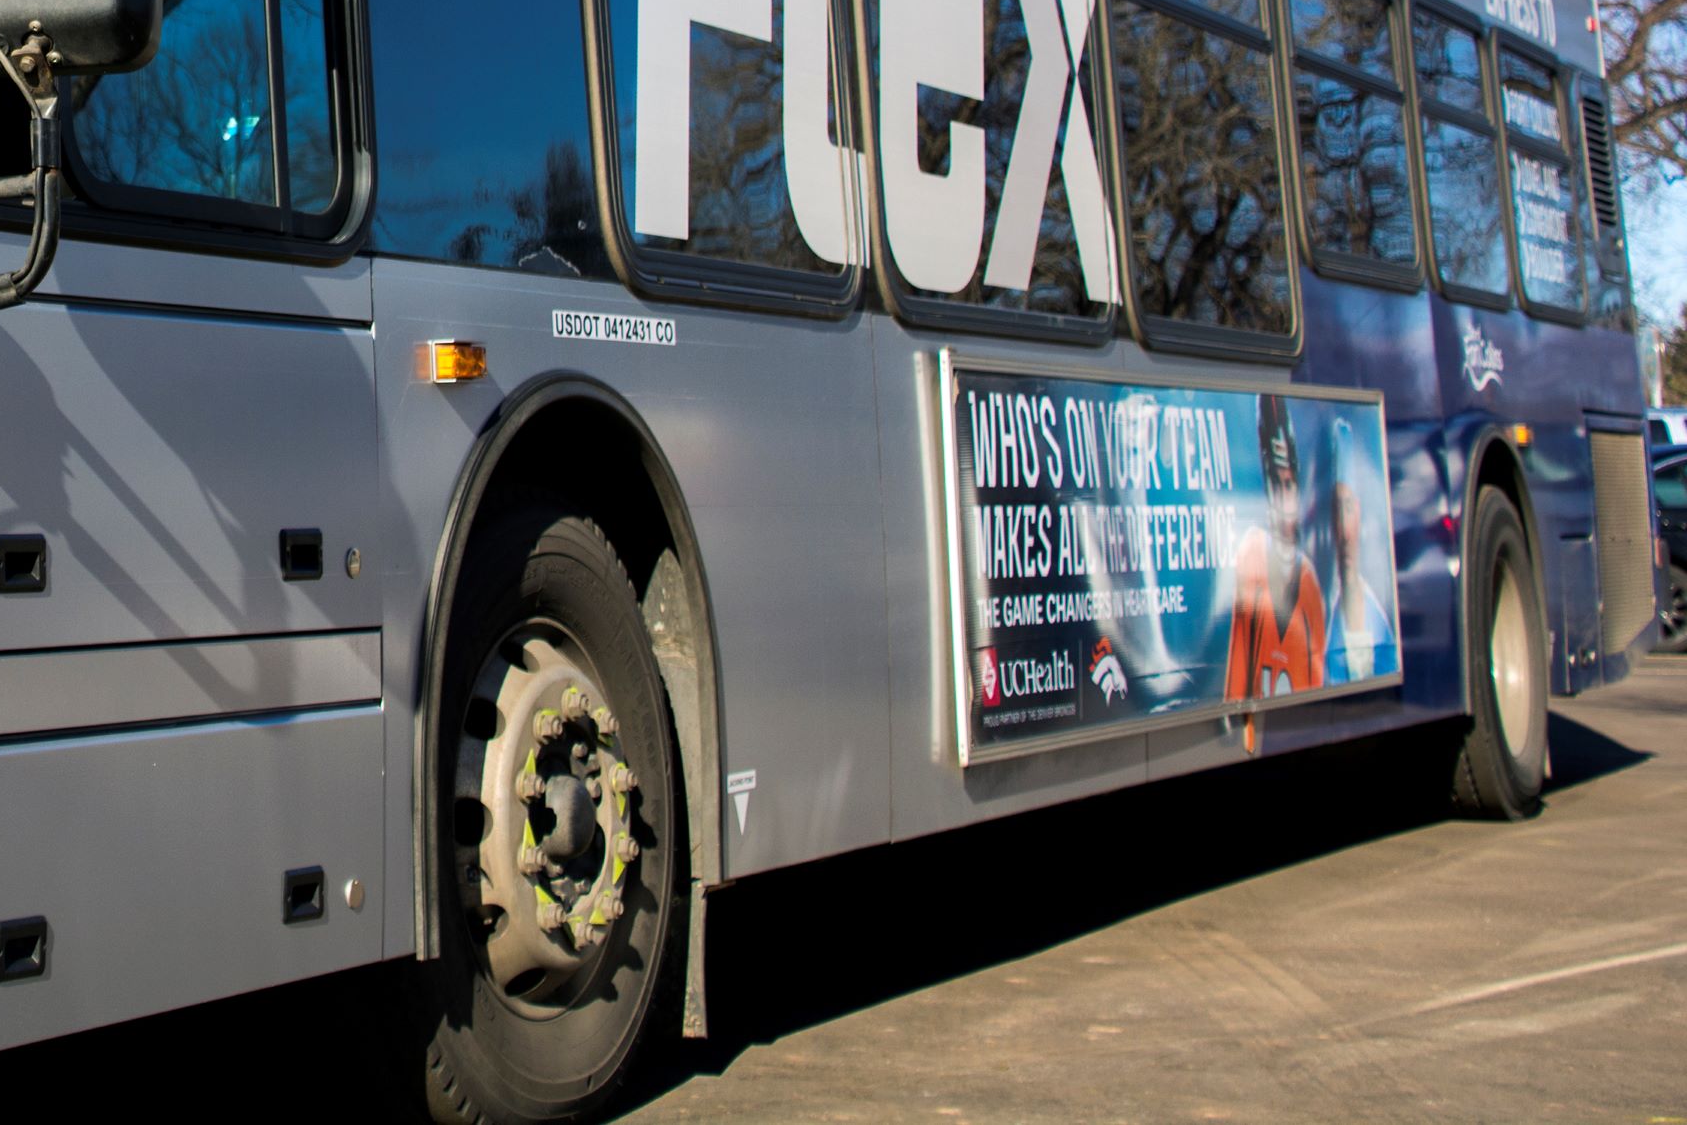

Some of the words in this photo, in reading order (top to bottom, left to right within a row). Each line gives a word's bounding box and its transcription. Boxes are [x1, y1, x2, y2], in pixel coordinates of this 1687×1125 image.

[556, 313, 600, 337] USDOT
[604, 317, 651, 342] 0412431
[655, 322, 673, 343] CO
[968, 391, 1063, 489] WHO'S
[1065, 397, 1101, 489] ON
[1099, 395, 1161, 489] YOUR
[1165, 406, 1233, 491] TEAM
[972, 505, 1052, 579] MAKES
[1059, 505, 1095, 576] ALL
[1097, 505, 1126, 574] THE
[1125, 504, 1238, 573] DIFFERENCE
[978, 597, 1000, 628] THE
[1003, 594, 1043, 626] GAME
[1046, 591, 1111, 625] CHANGERS
[1113, 590, 1123, 619] IN
[1152, 585, 1188, 614] CARE.
[1000, 650, 1075, 698] UCHealth
